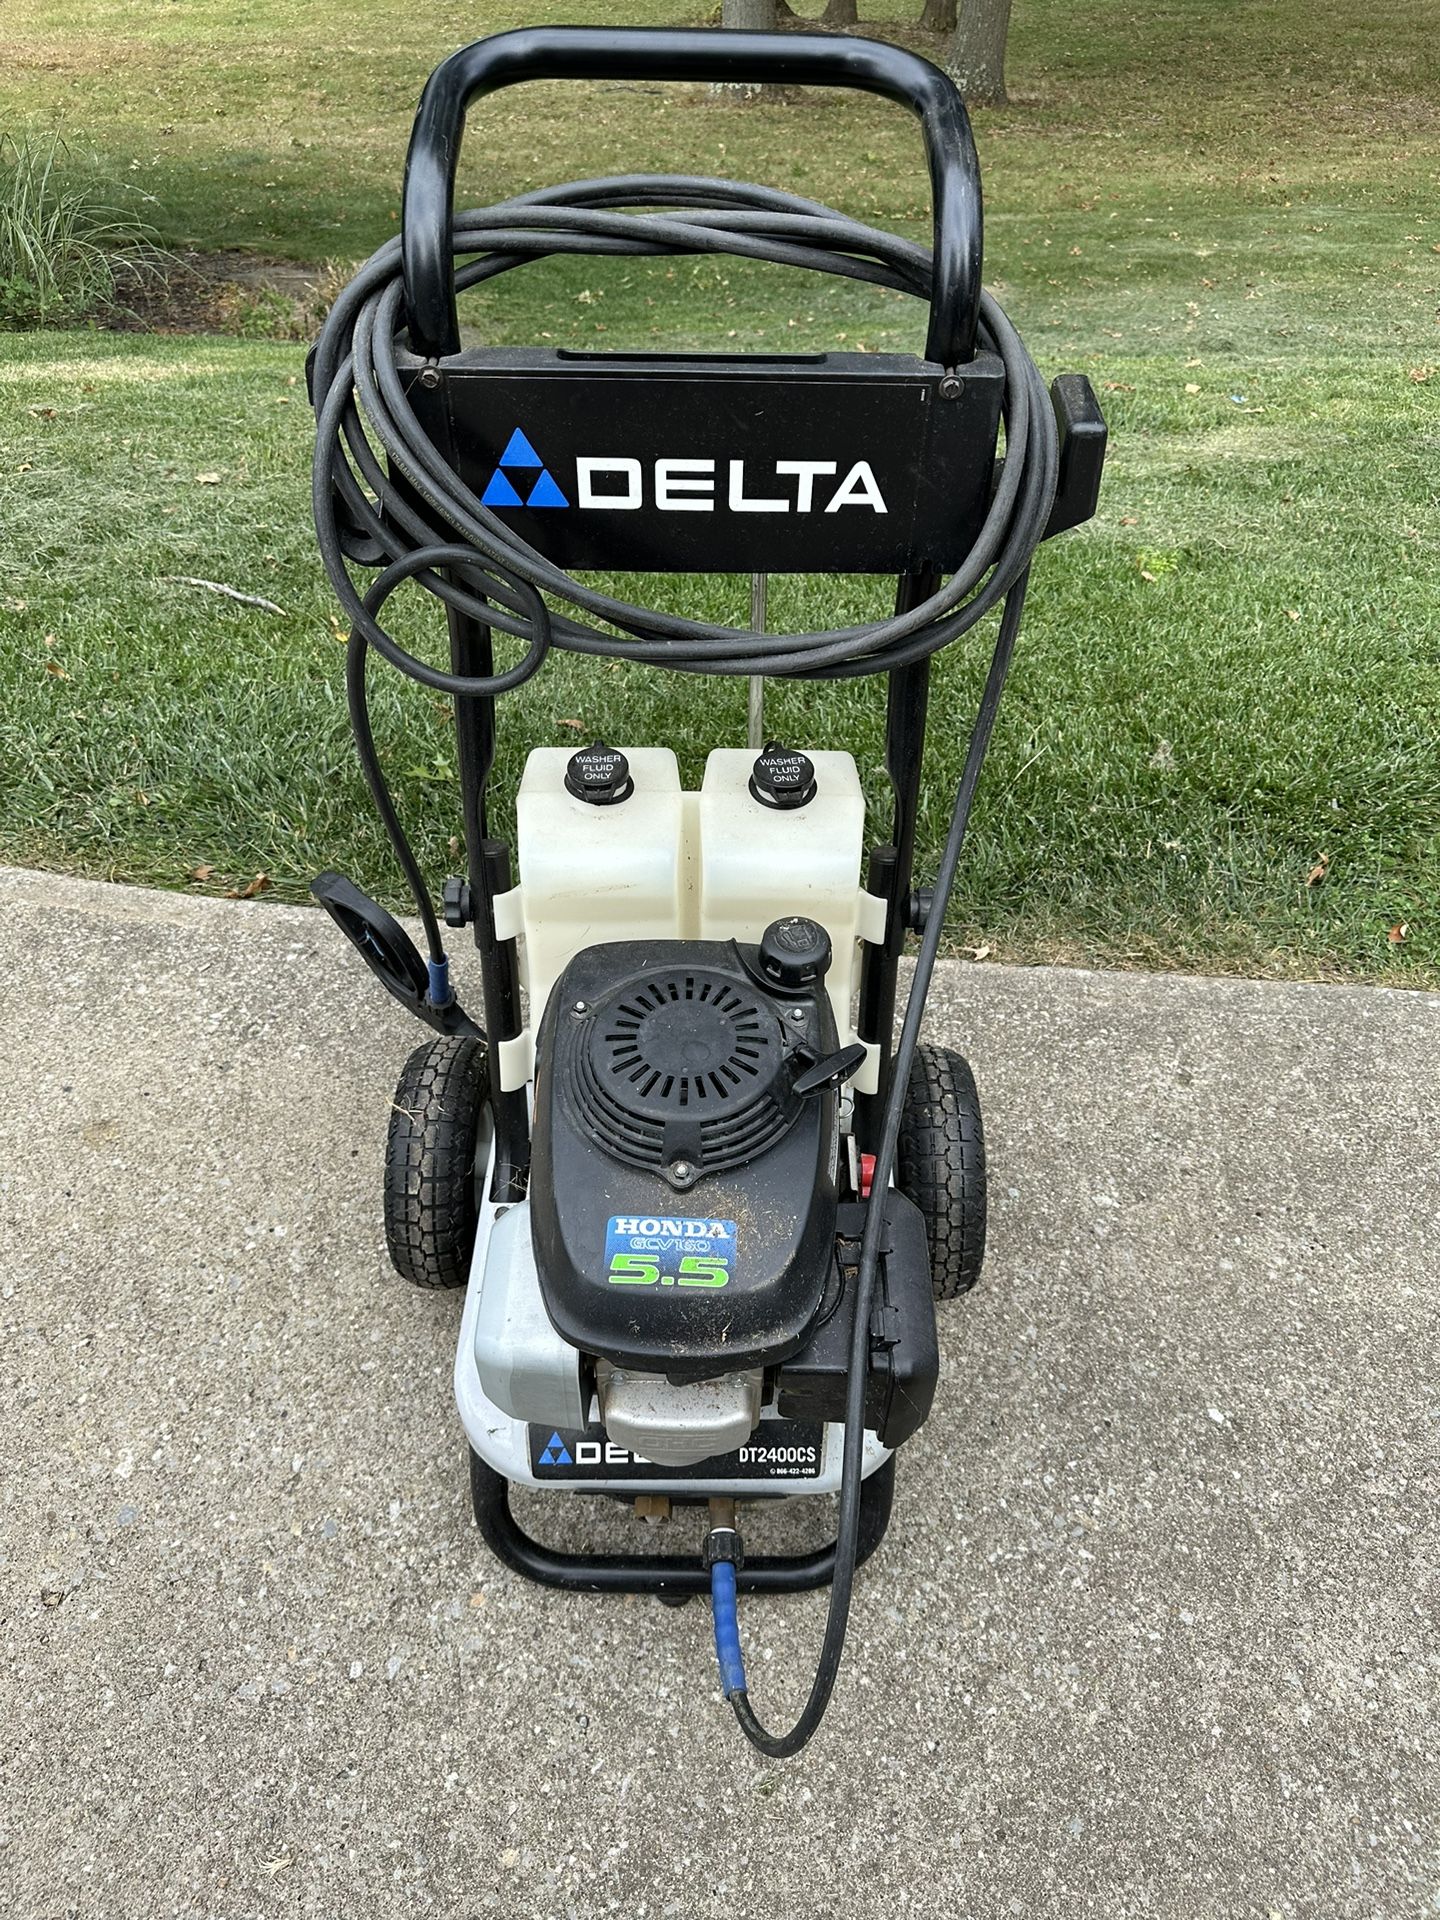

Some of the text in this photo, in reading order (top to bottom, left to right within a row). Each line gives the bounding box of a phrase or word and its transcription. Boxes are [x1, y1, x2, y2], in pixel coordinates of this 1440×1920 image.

[576, 456, 889, 514] DELTA
[575, 754, 621, 763] WASHER
[760, 756, 806, 766] WASHER
[582, 763, 614, 771] FLUID
[769, 765, 801, 774] FLUID
[584, 772, 612, 780] ONLY
[773, 774, 800, 782] ONLY
[614, 1218, 731, 1239] HONDA
[630, 1237, 711, 1251] GCV160
[608, 1253, 730, 1288] 5.5
[739, 1446, 817, 1463] DT2400CS
